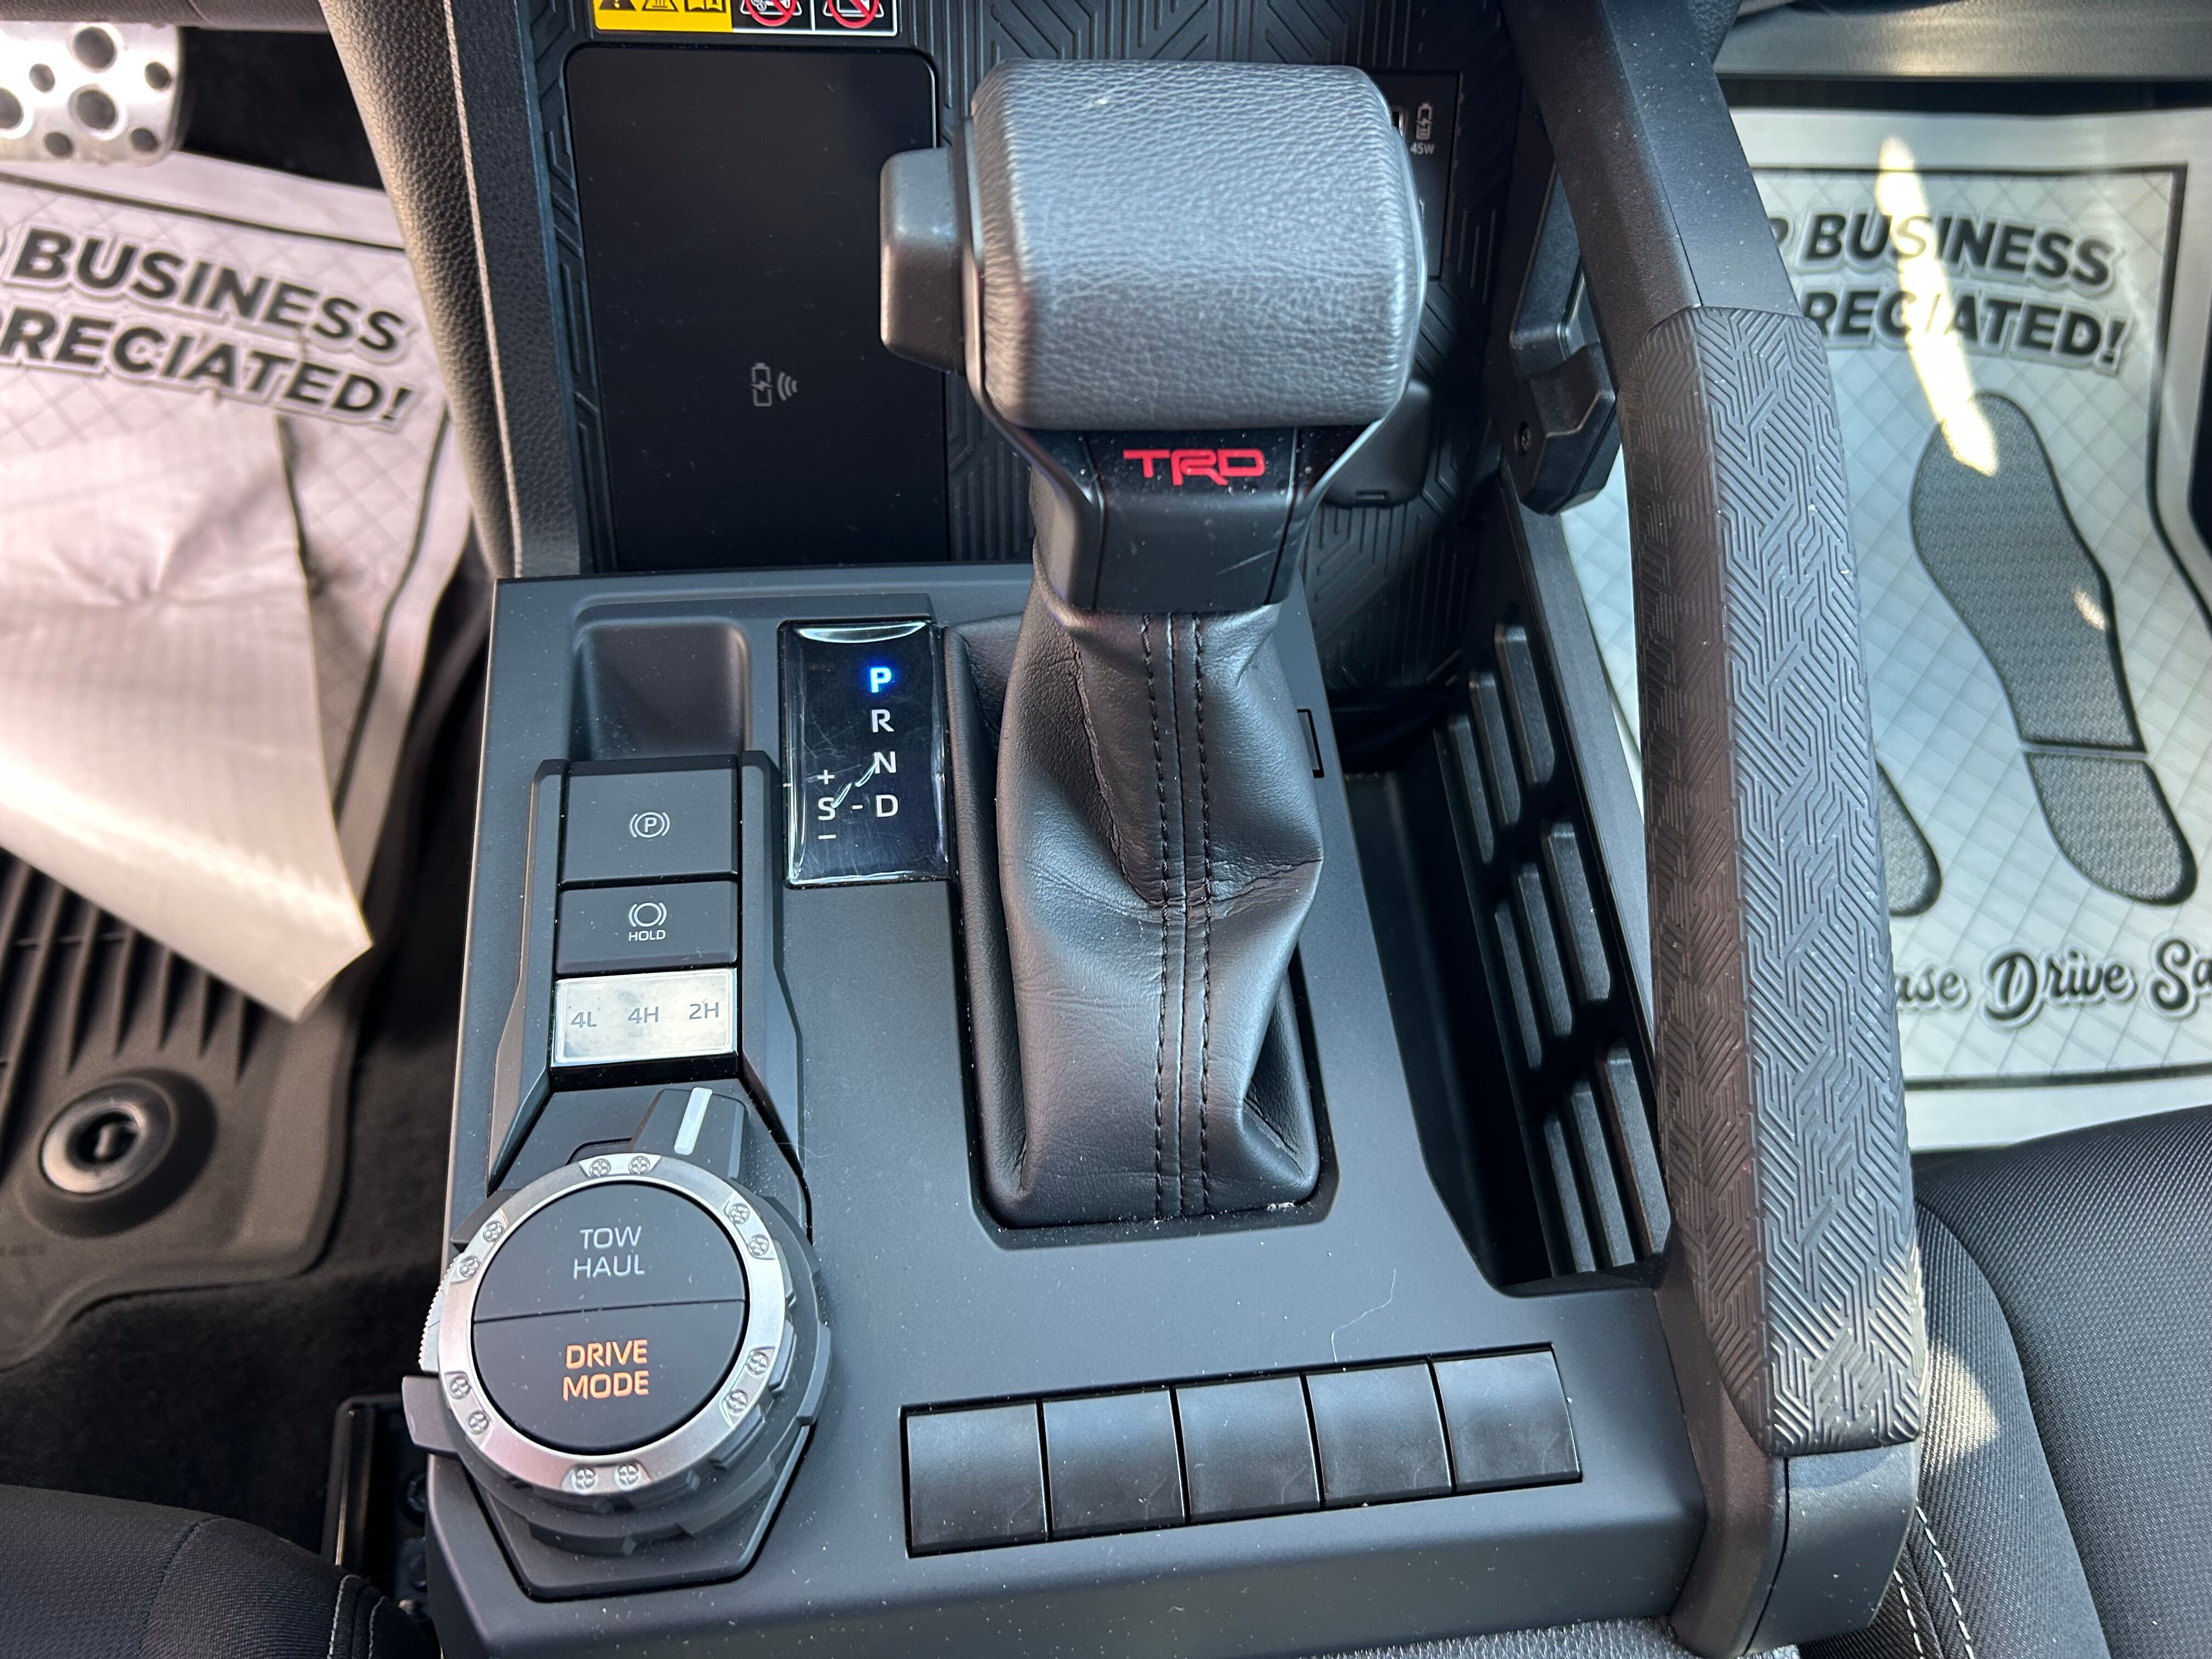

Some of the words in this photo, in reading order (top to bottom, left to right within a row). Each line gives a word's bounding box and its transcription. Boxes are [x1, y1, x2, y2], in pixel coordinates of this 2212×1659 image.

[1410, 142, 1436, 155] 45W
[1805, 213, 2113, 286] BUSINESS
[11, 225, 407, 352] BUSINESS
[1122, 448, 1266, 486] TRD
[870, 666, 892, 693] P
[871, 709, 894, 733] R
[873, 751, 896, 774] N
[818, 797, 836, 821] S
[876, 794, 899, 817] D
[629, 929, 667, 942] HOLD
[1984, 949, 2130, 1019] Drive
[571, 1012, 597, 1028] 4L
[628, 1006, 659, 1024] 4H
[689, 1002, 720, 1020] 2H
[580, 1225, 642, 1250] TOW
[573, 1253, 645, 1280] HAUL
[565, 1339, 648, 1370] DRIVE
[562, 1370, 650, 1401] MODE
